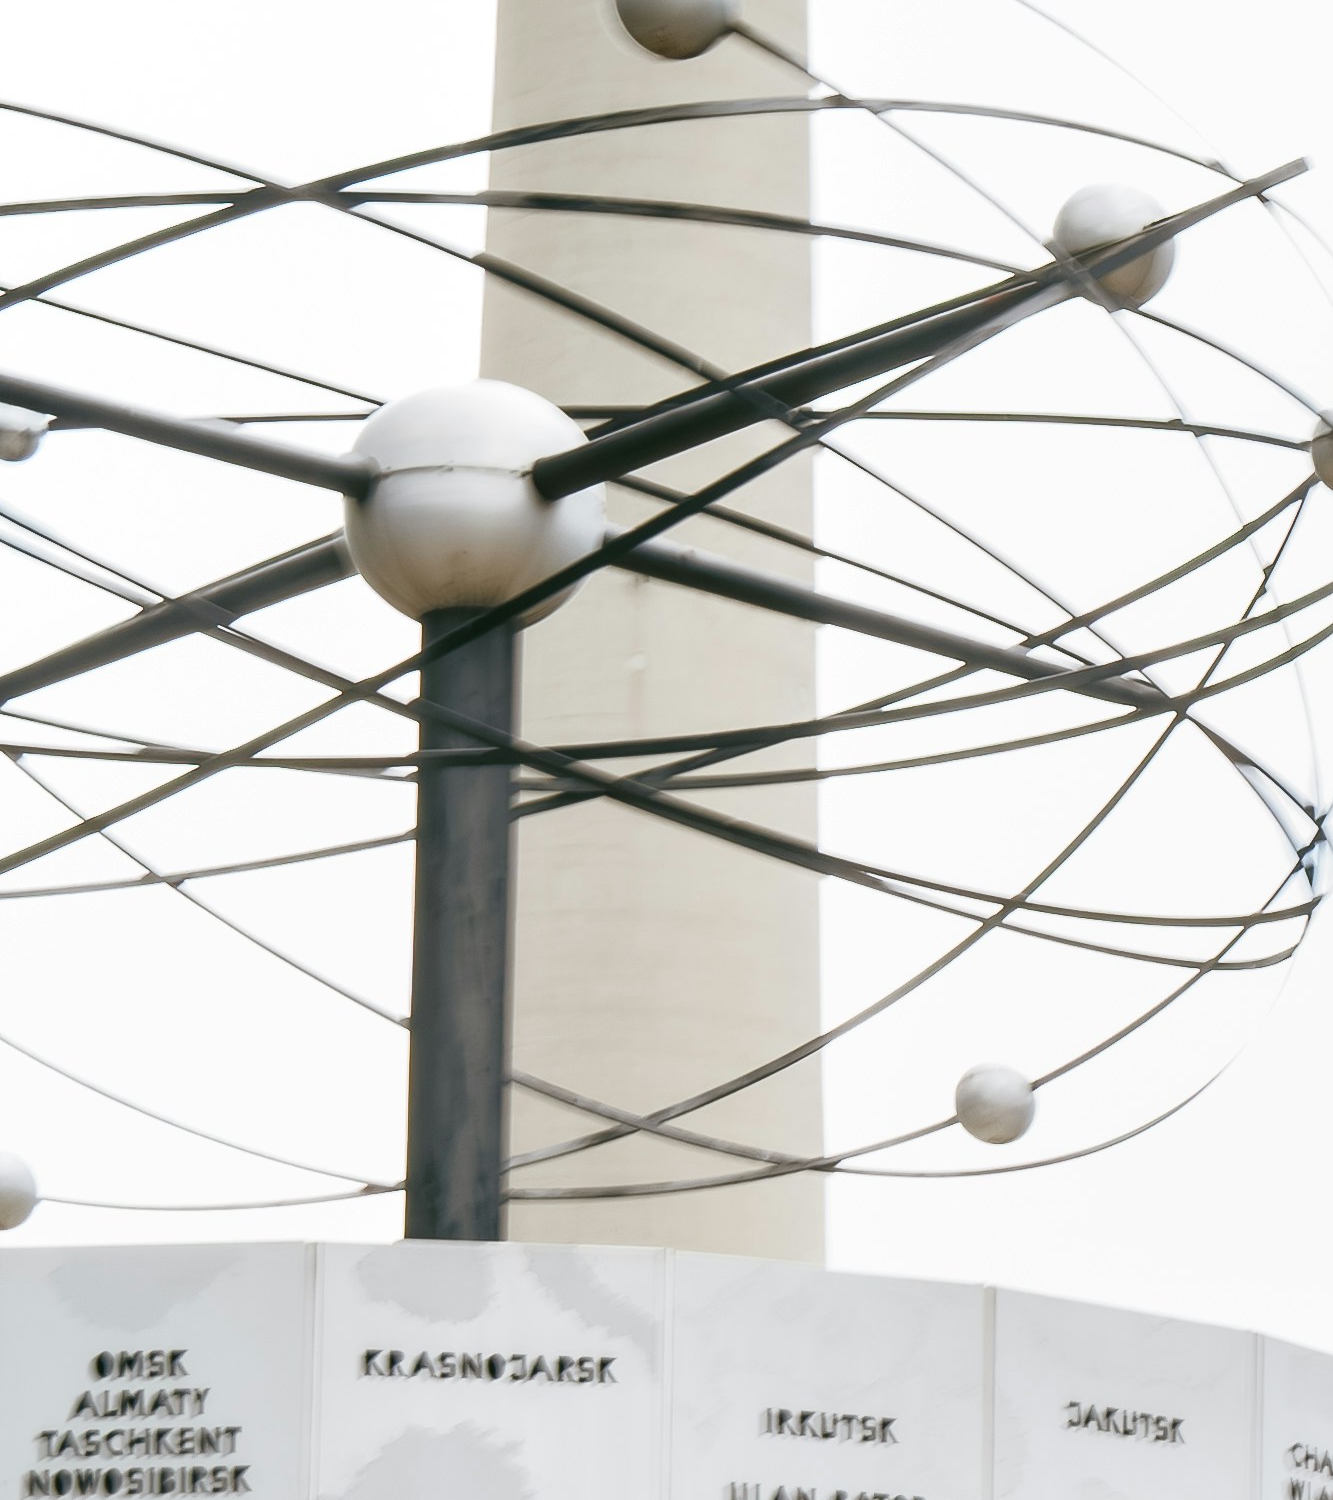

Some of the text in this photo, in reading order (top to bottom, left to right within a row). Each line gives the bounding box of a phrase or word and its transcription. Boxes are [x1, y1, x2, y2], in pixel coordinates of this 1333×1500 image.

[89, 1349, 190, 1380] OMSK
[358, 1349, 618, 1384] KRASNOJARSK
[67, 1388, 211, 1420] ALMATY
[759, 1408, 899, 1444] IRKUTSK
[1063, 1400, 1186, 1444] JAKUTSK
[34, 1426, 242, 1460] TASCHKENT
[20, 1465, 253, 1500] NOWOSIBIRSK
